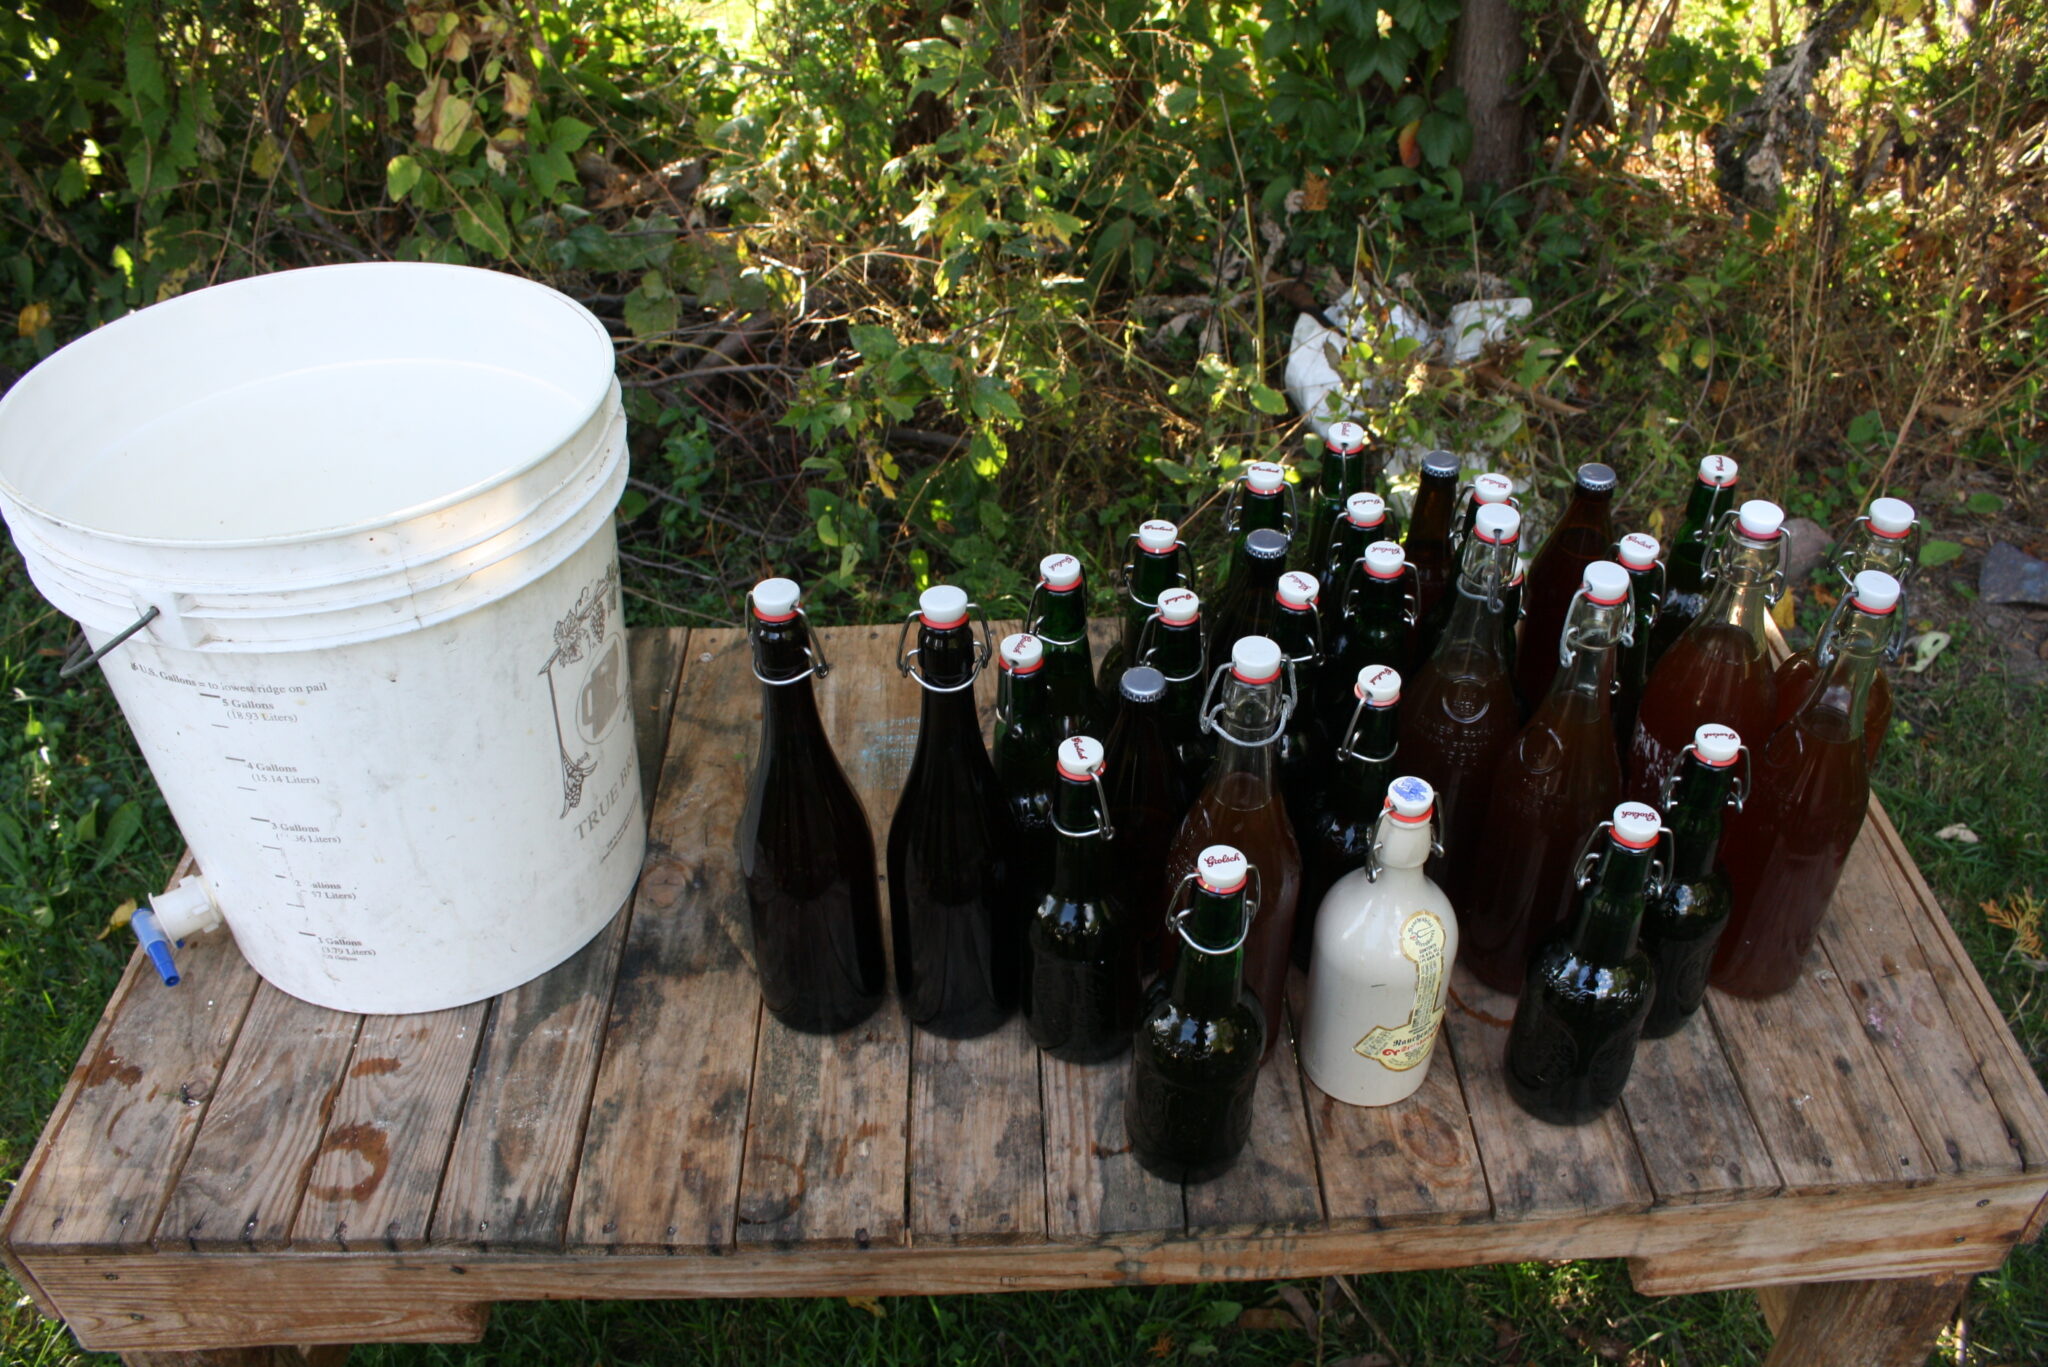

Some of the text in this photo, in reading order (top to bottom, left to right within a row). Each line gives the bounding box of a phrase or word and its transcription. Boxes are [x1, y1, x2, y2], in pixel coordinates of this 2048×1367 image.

[138, 664, 158, 678] U.S.
[159, 671, 196, 688] Gallons
[207, 682, 218, 691] to
[257, 682, 286, 696] ridge
[306, 682, 328, 696] pail
[222, 698, 274, 710] 5 Gallons
[261, 712, 298, 723] Liters)
[256, 763, 298, 773] Gallons
[285, 775, 321, 784] Liters)
[574, 782, 620, 840] TRUE
[1621, 810, 1657, 822] Grolsch
[271, 822, 320, 833] 3 Gallons
[307, 835, 341, 844] Liters)
[1203, 852, 1241, 867] Grolsch
[324, 891, 357, 900] Liters)
[324, 937, 362, 947] Gallons
[345, 947, 377, 957] Liters)
